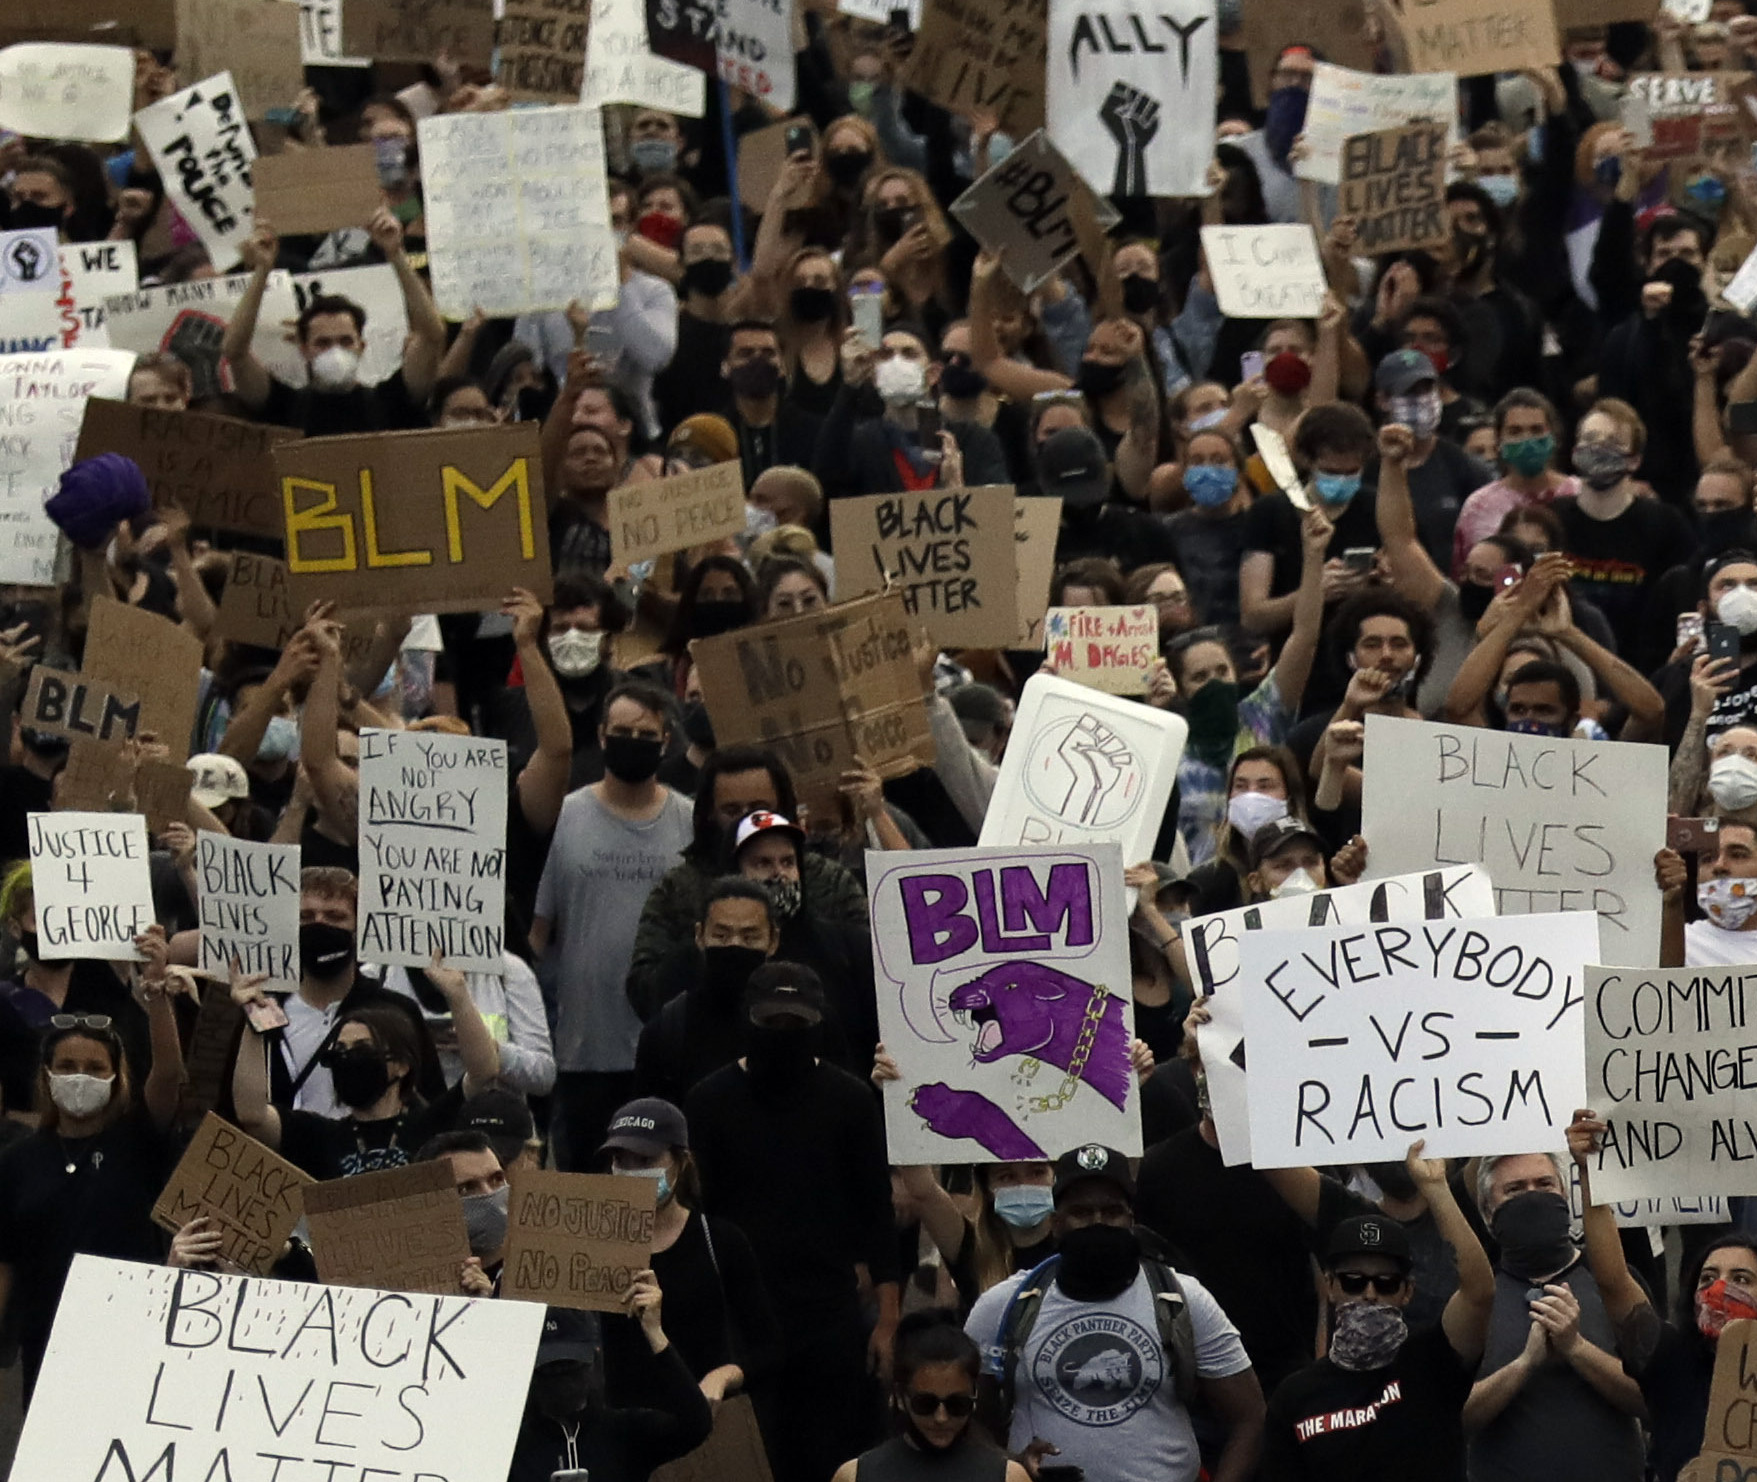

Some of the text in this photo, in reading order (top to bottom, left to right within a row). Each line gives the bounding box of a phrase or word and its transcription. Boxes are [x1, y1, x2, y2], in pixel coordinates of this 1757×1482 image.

[1069, 13, 1210, 87] ALLY
[1628, 76, 1715, 108] SERVE
[1344, 131, 1443, 181] BLACK
[1344, 167, 1436, 212] LIVES
[281, 457, 537, 575] BLM
[875, 494, 978, 534] BLACK
[874, 530, 972, 579] LIVES
[35, 676, 141, 742] BLM
[1435, 735, 1608, 798] BLACK
[30, 824, 138, 862] JUSTICE
[1435, 807, 1615, 877] LIVES
[201, 852, 297, 895] BLACK
[380, 873, 485, 914] PAYING
[201, 897, 269, 935] LIVES
[361, 912, 503, 960] ATTENTION
[899, 863, 1095, 967] BLM
[1265, 928, 1585, 1030] EVERYBODY
[1296, 1070, 1553, 1147] RACISM
[163, 1268, 467, 1383] BLACK
[145, 1362, 428, 1452] LIVES
